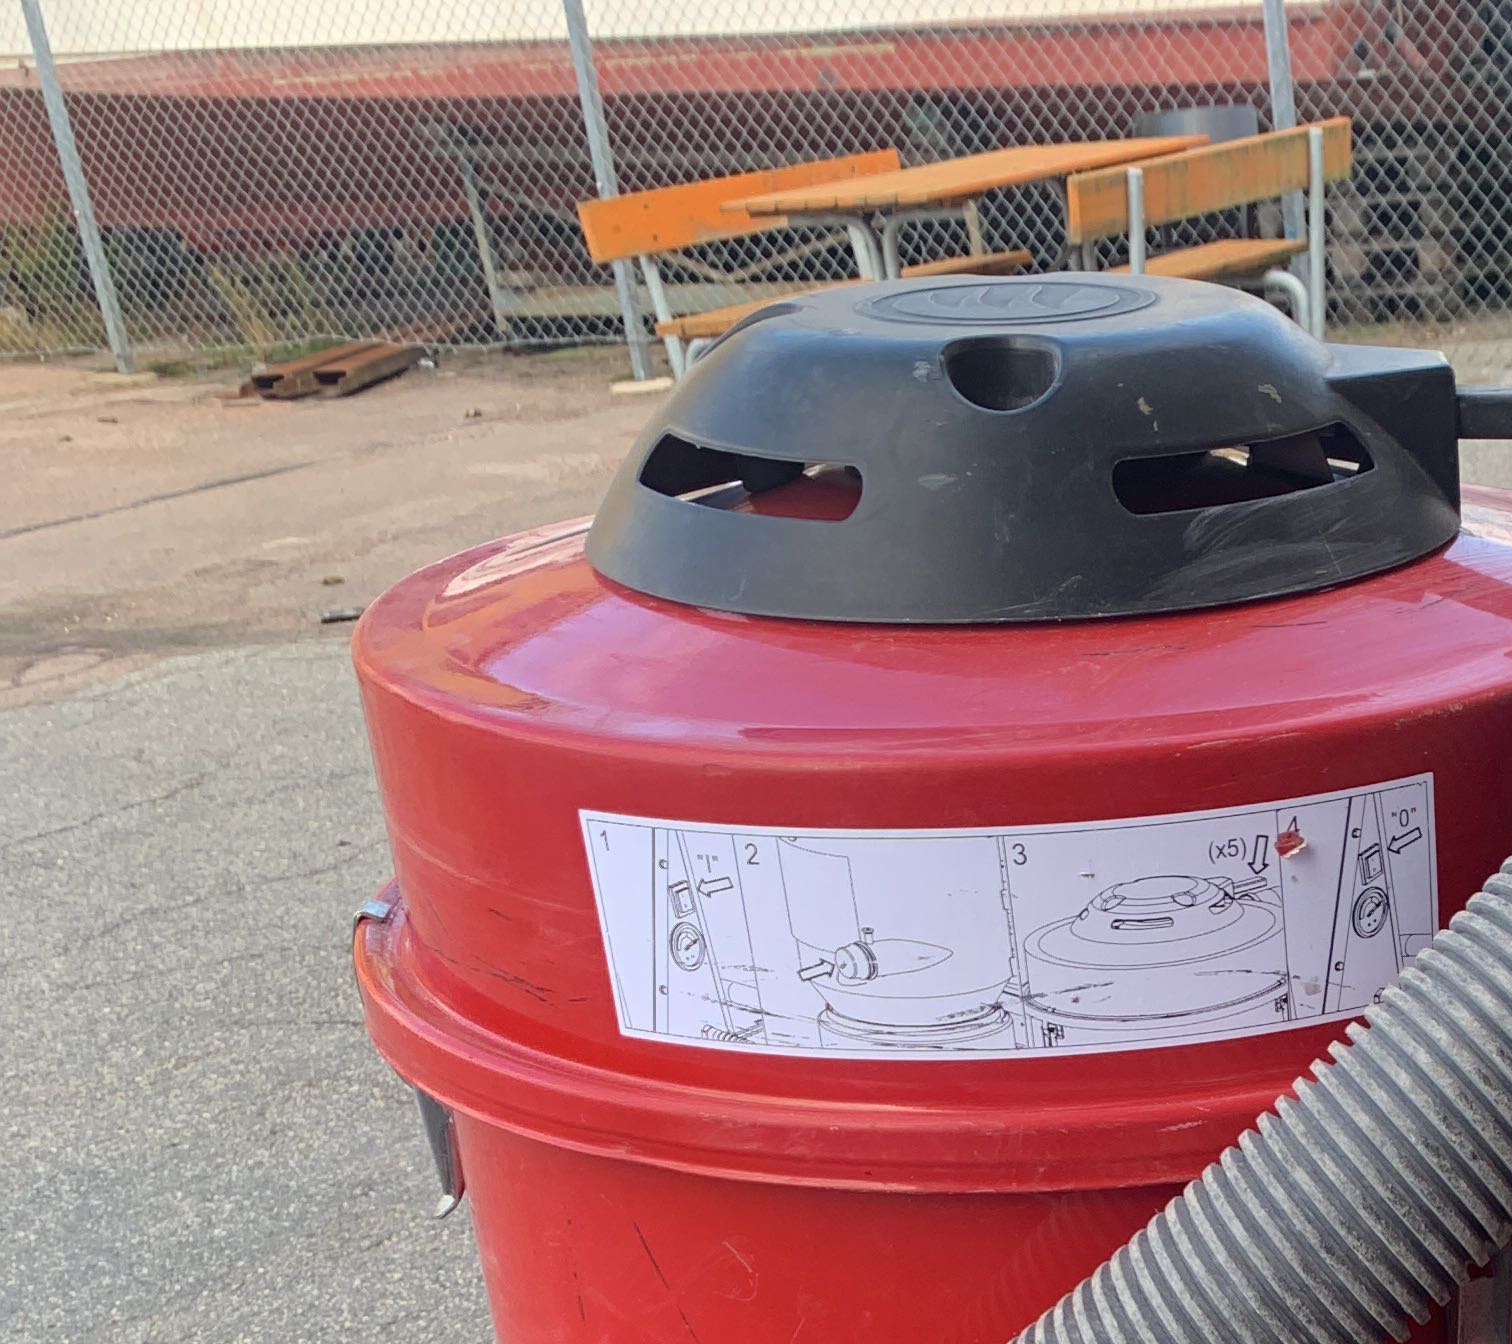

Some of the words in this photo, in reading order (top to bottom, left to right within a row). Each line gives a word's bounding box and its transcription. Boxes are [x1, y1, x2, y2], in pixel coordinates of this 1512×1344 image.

[599, 830, 610, 851] 1
[1208, 836, 1248, 866] (x5)
[744, 843, 761, 865] 2
[1011, 844, 1028, 866] 3
